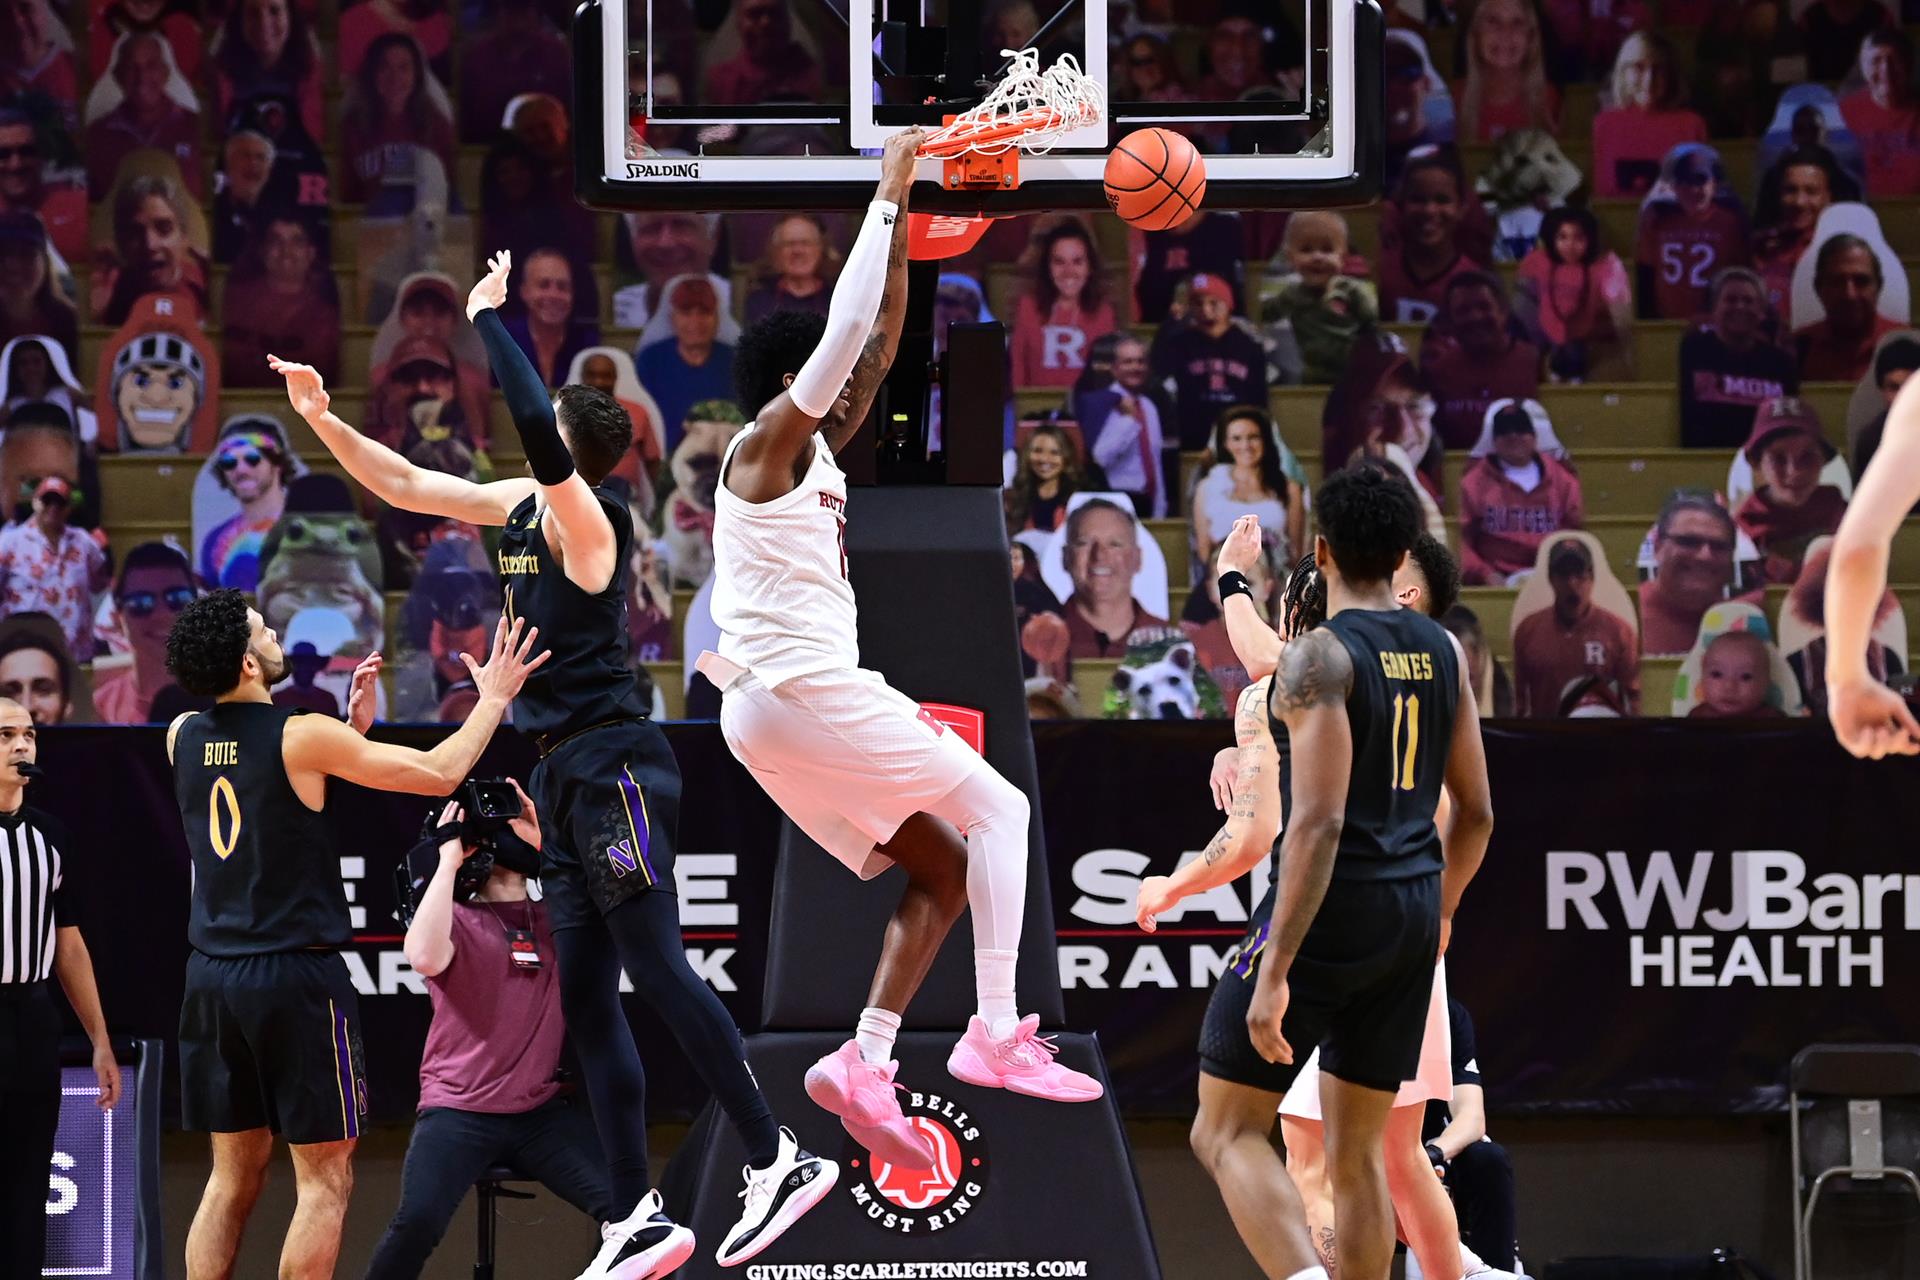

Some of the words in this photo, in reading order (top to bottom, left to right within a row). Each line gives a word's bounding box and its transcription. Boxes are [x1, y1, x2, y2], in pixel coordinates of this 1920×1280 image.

[298, 174, 328, 204] R
[626, 162, 699, 179] SPALDING
[1663, 242, 1714, 288] 52
[155, 299, 173, 315] R
[1042, 325, 1086, 369] R
[1584, 641, 1605, 666] R
[203, 741, 238, 766] BUIE
[1391, 692, 1419, 790] 11
[209, 775, 241, 861] 0
[606, 839, 637, 878] N
[1629, 935, 1884, 988] HEALTH
[911, 1092, 980, 1141] BELLS
[851, 1182, 914, 1233] MUST
[927, 1181, 982, 1232] RING
[746, 1260, 1087, 1280] GIVING.SCARLETKNIGHTS.COM
